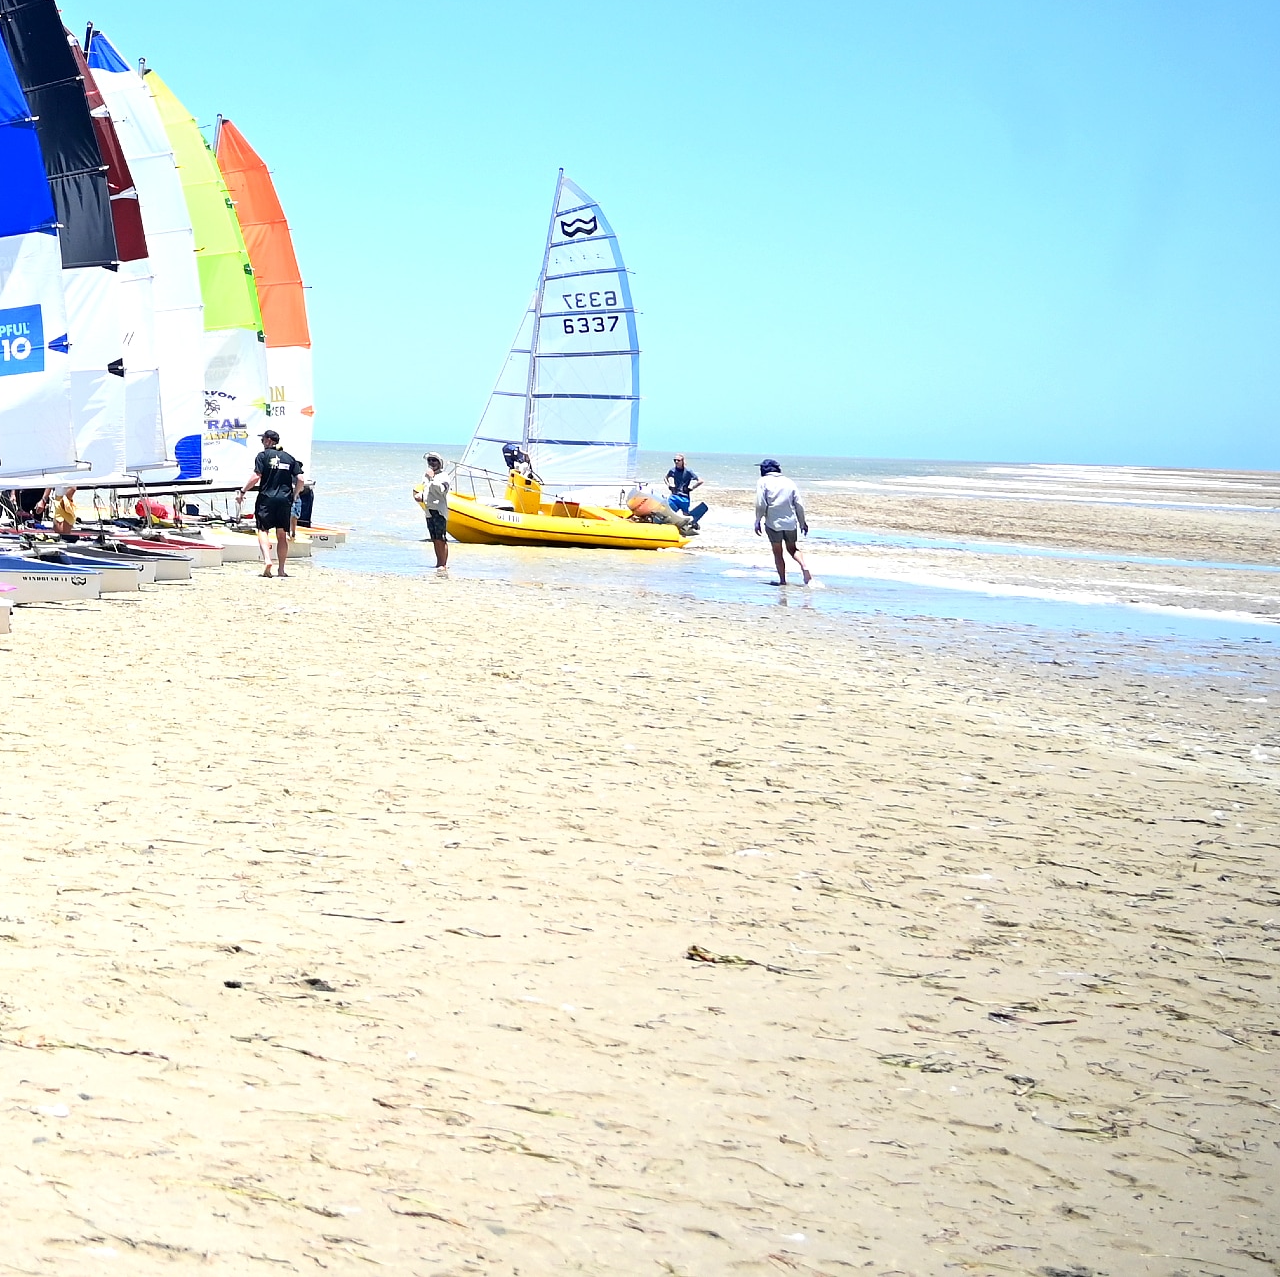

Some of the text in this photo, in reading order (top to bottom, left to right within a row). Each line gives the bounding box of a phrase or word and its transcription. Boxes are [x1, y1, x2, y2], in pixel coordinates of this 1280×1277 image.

[563, 316, 619, 334] 6337
[1, 337, 32, 361] 10
[204, 418, 247, 430] RAL
